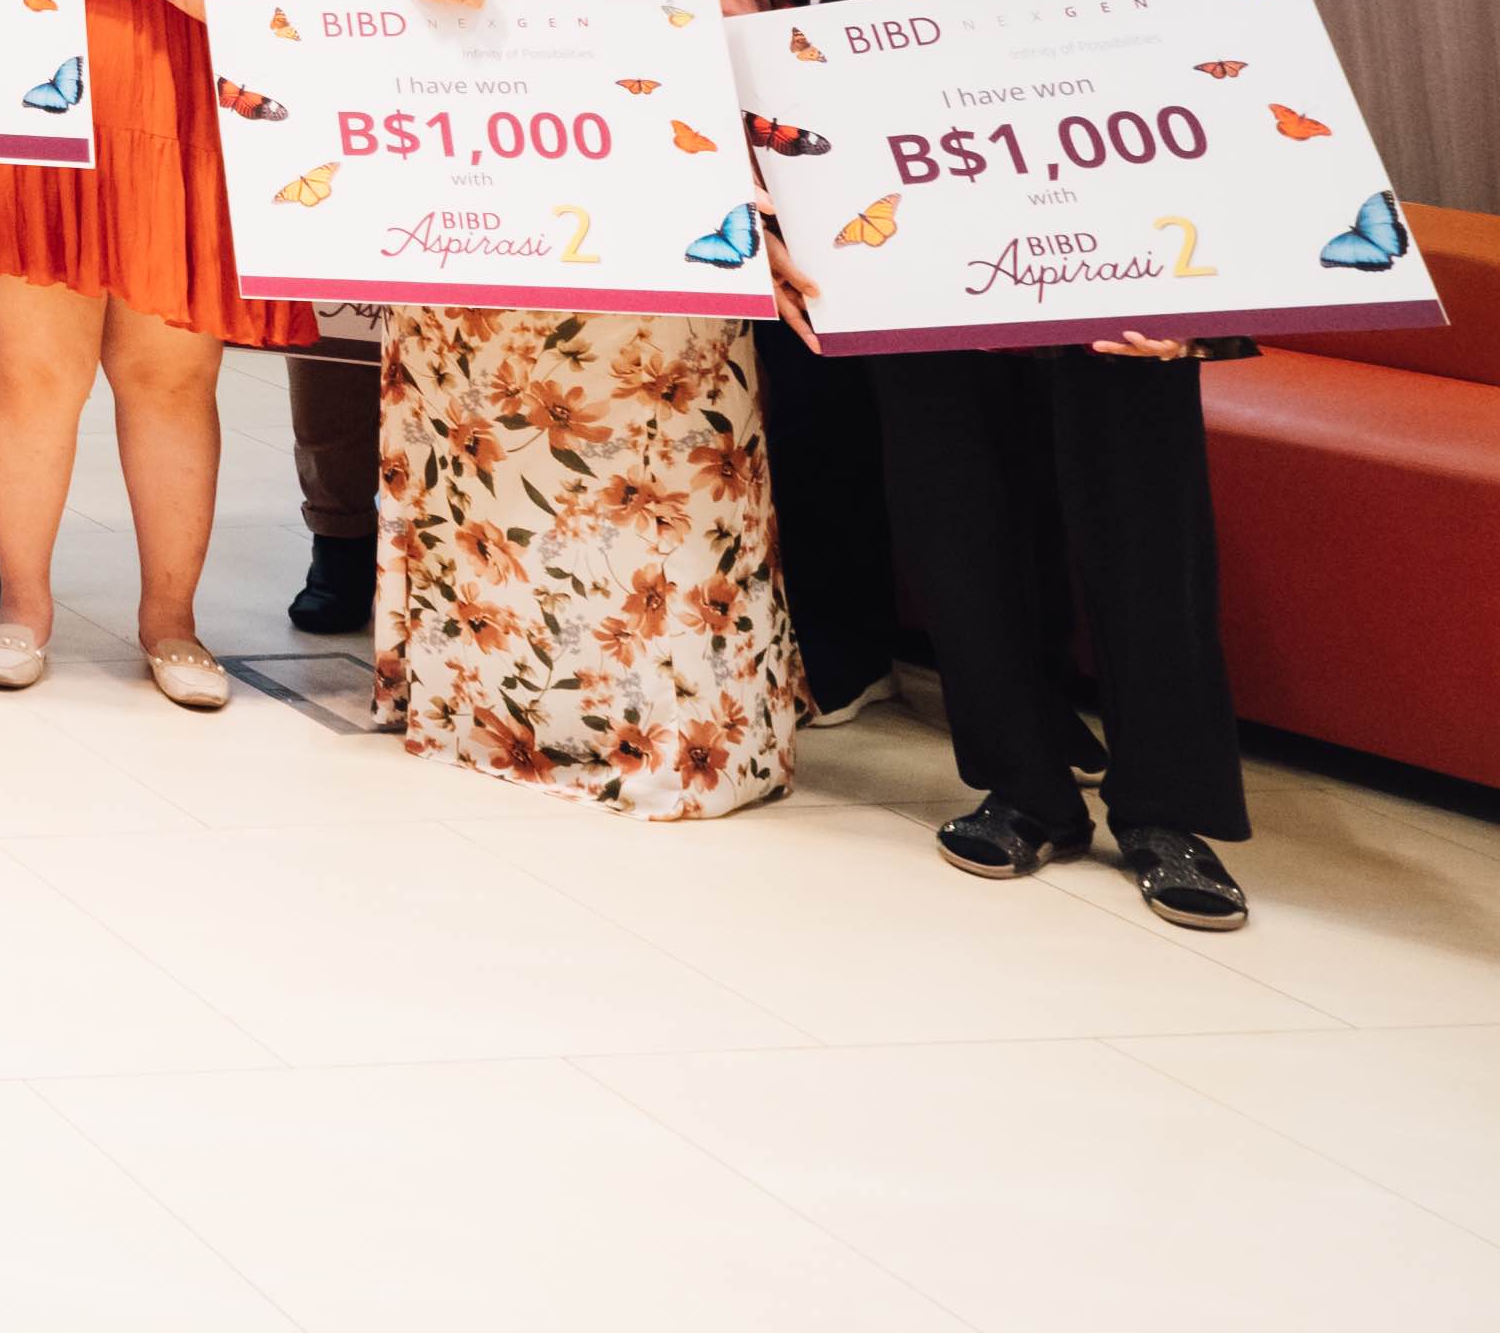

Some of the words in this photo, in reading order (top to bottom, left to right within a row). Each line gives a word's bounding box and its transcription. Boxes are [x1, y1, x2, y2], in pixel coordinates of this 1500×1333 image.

[322, 11, 406, 37] BIBD
[845, 17, 942, 54] BIBD
[393, 77, 402, 95] I
[409, 76, 468, 95] have
[473, 80, 527, 95] won
[939, 90, 953, 110] I
[957, 86, 1027, 107] have
[1030, 78, 1095, 100] won
[339, 109, 613, 165] B$1,000
[886, 105, 1208, 185] B$1,000
[449, 172, 493, 187] with
[1026, 188, 1078, 206] with
[441, 211, 501, 230] BIBD
[379, 210, 553, 270] Aspirasi
[554, 205, 601, 264] 2
[1026, 232, 1098, 257] BIBD
[965, 237, 1163, 304] Aspirasi
[1153, 215, 1215, 279] 2
